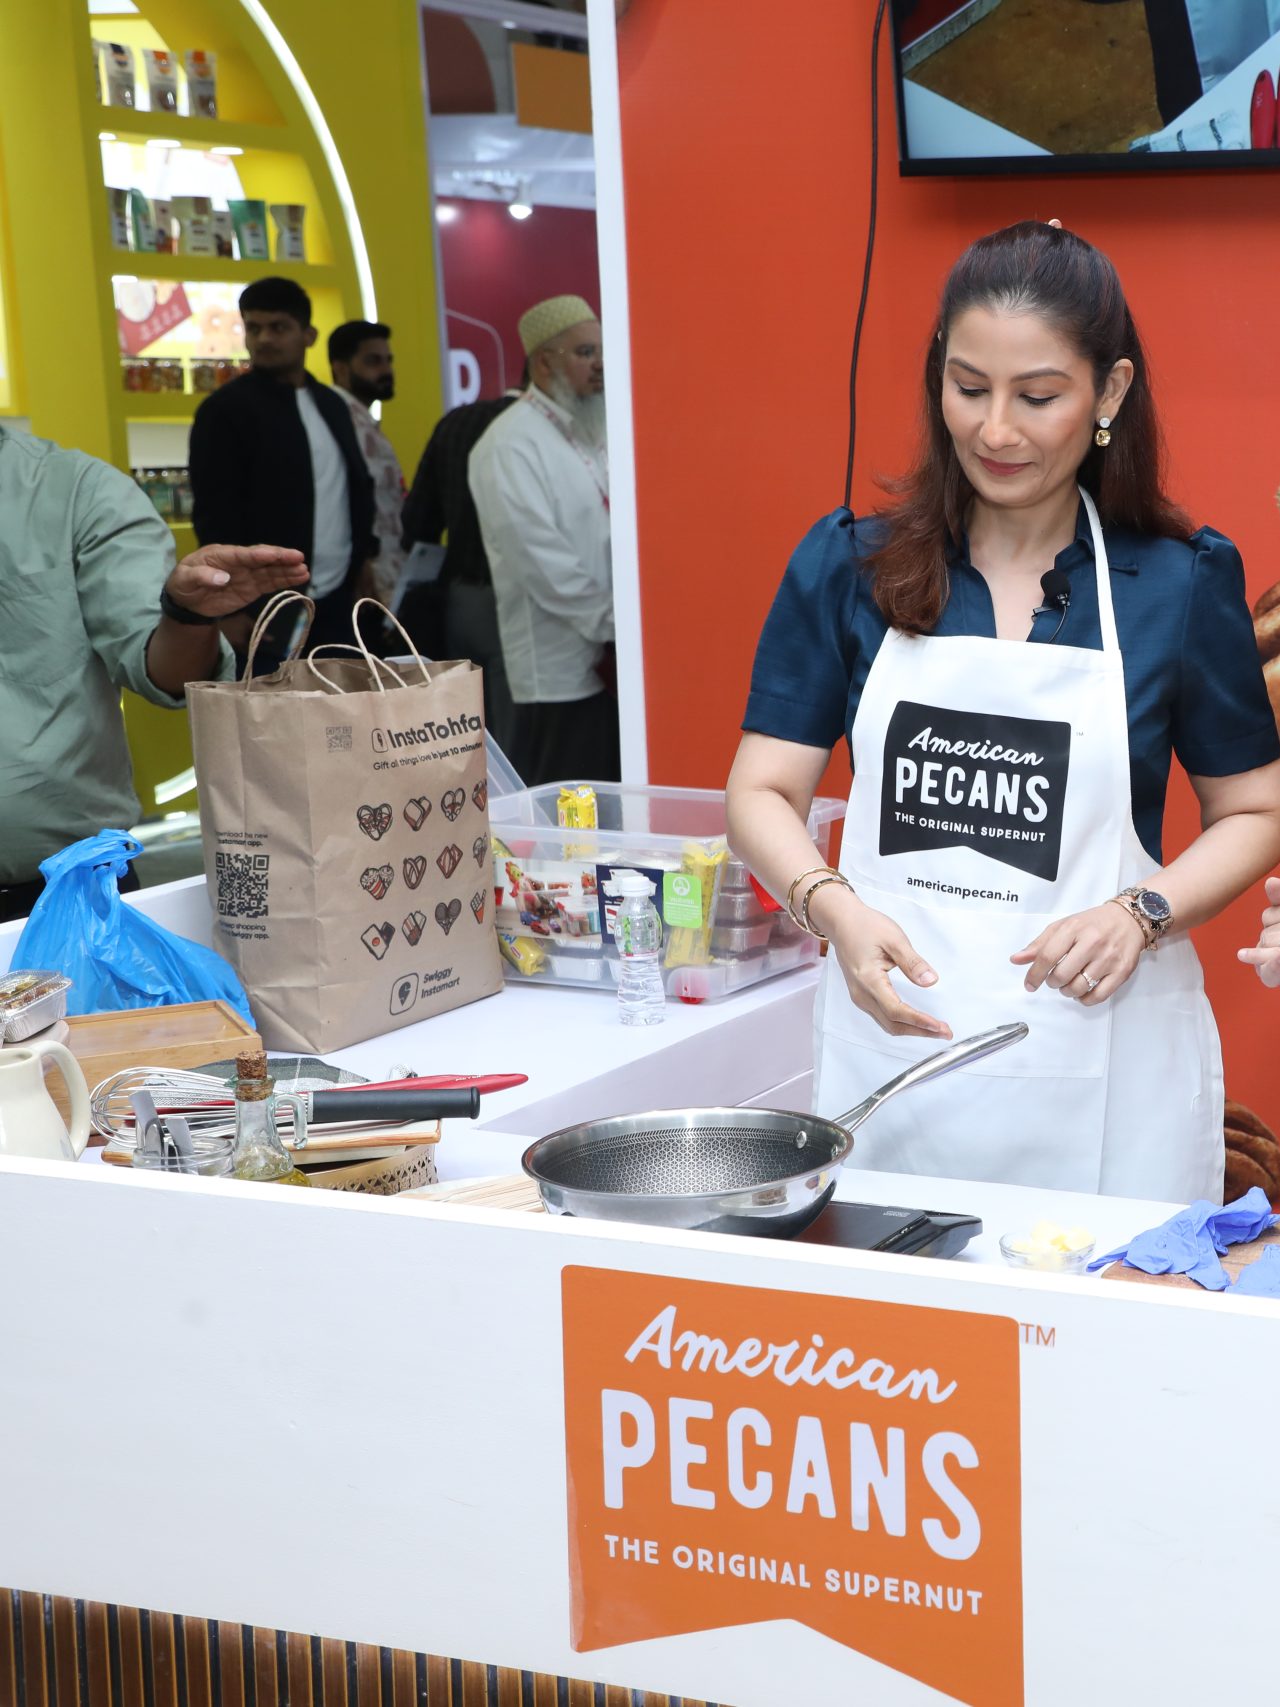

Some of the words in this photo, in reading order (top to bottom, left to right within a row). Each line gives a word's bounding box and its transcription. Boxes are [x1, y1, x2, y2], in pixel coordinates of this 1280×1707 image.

[387, 713, 482, 749] InstaTohfa
[907, 727, 1044, 766] American
[373, 761, 389, 771] Gift
[400, 757, 419, 766] things
[419, 754, 432, 762] love
[439, 750, 450, 760] just
[450, 748, 459, 756] 10
[895, 756, 1050, 823] PECANS
[895, 811, 915, 825] THE
[919, 817, 976, 835] ORIGINAL
[980, 826, 1046, 843] SUPERNUT
[907, 876, 1019, 902] americanpecan.in
[421, 977, 460, 999] Instamart
[423, 967, 453, 984] Swiggy
[1020, 1322, 1056, 1348] TM
[623, 1304, 958, 1404] American
[601, 1387, 982, 1561] PECANS
[604, 1533, 659, 1565] THE
[671, 1544, 811, 1589] ORIGINAL
[824, 1567, 983, 1616] SUPERNUT
